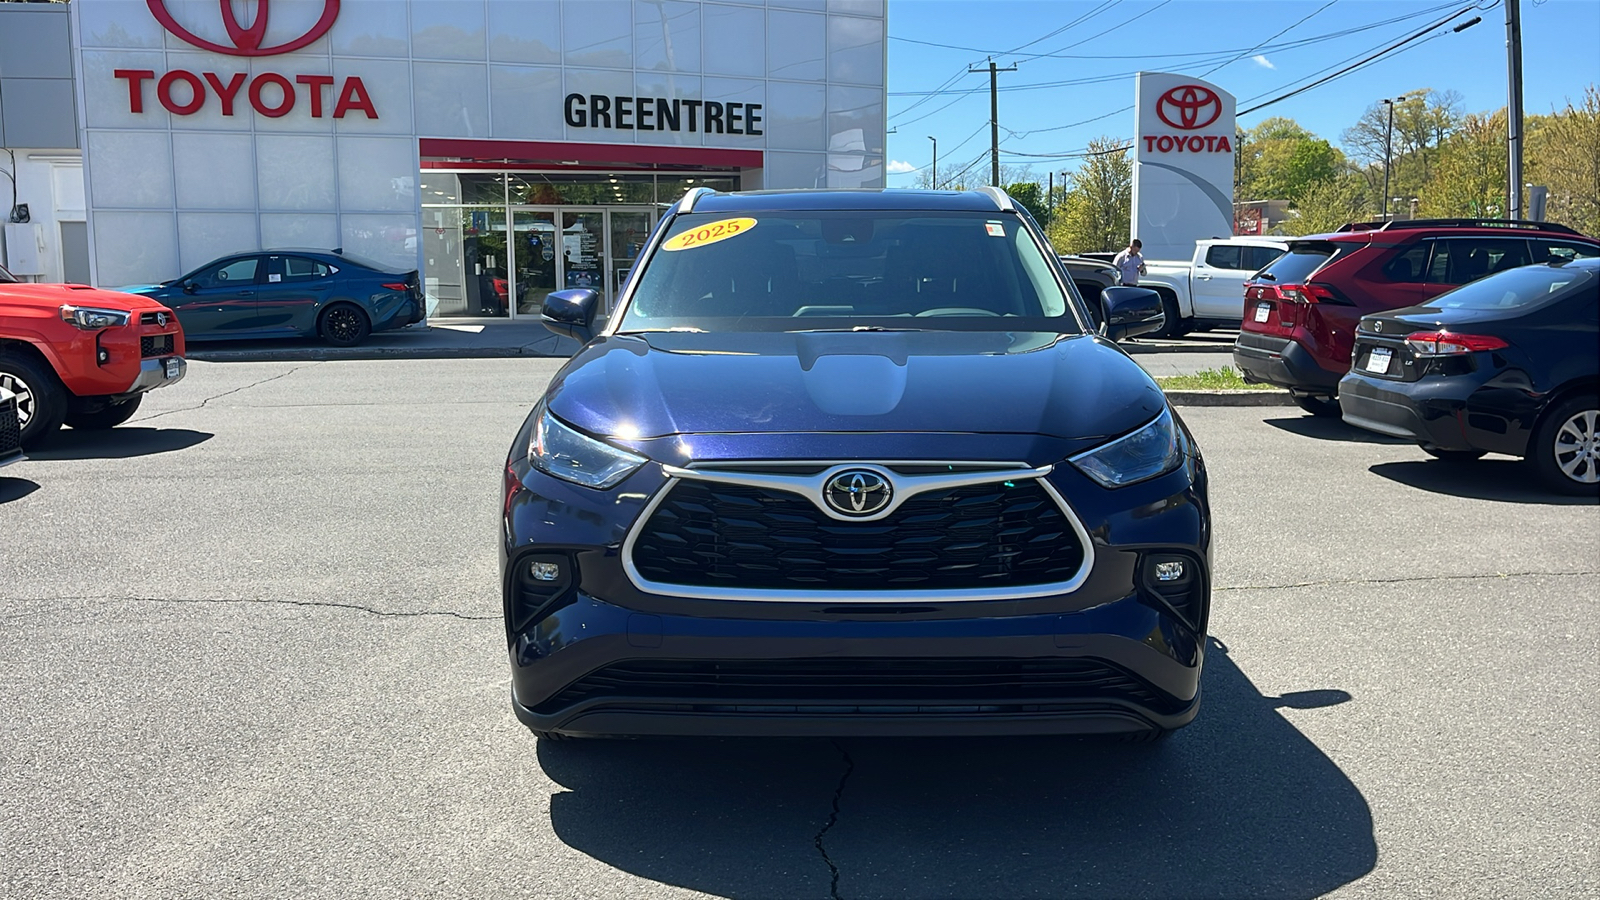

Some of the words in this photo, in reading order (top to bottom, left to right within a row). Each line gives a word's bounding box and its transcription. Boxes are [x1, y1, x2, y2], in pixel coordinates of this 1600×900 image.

[114, 69, 379, 119] TOYOTA
[564, 93, 763, 135] GREENTREE
[1143, 135, 1232, 153] TOYOTA
[682, 221, 740, 247] 2025
